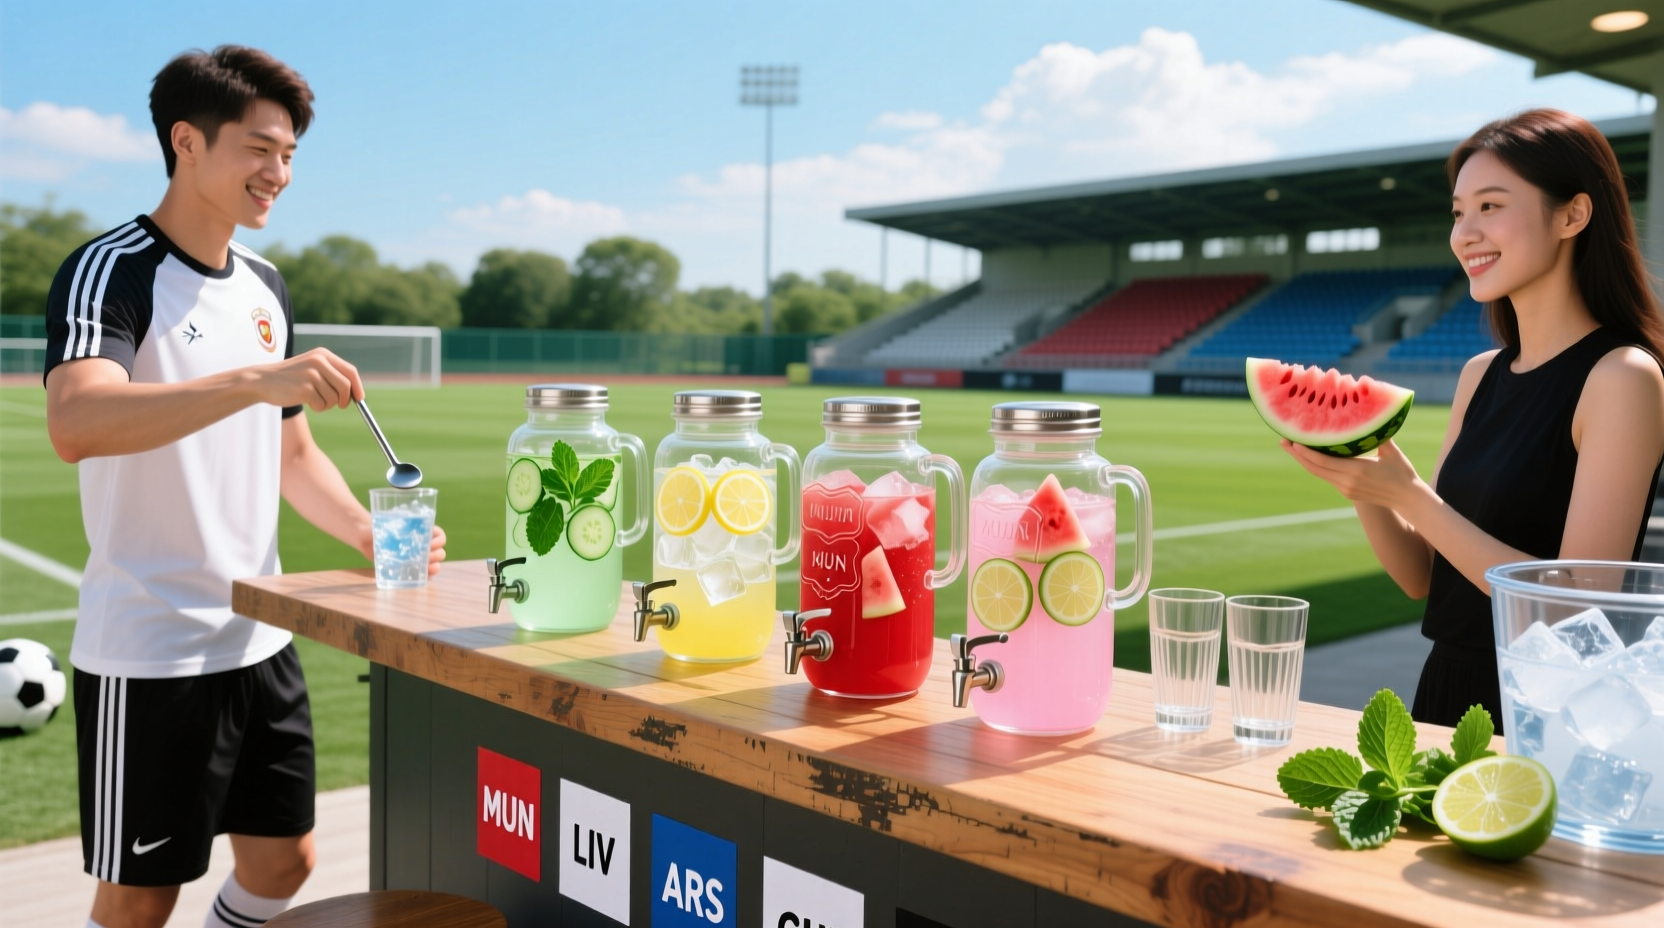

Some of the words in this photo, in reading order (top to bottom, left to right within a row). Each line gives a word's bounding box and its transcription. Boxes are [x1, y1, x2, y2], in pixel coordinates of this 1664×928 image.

[483, 785, 534, 841] MUN
[574, 823, 616, 876] LIV
[662, 862, 724, 924] ARS
